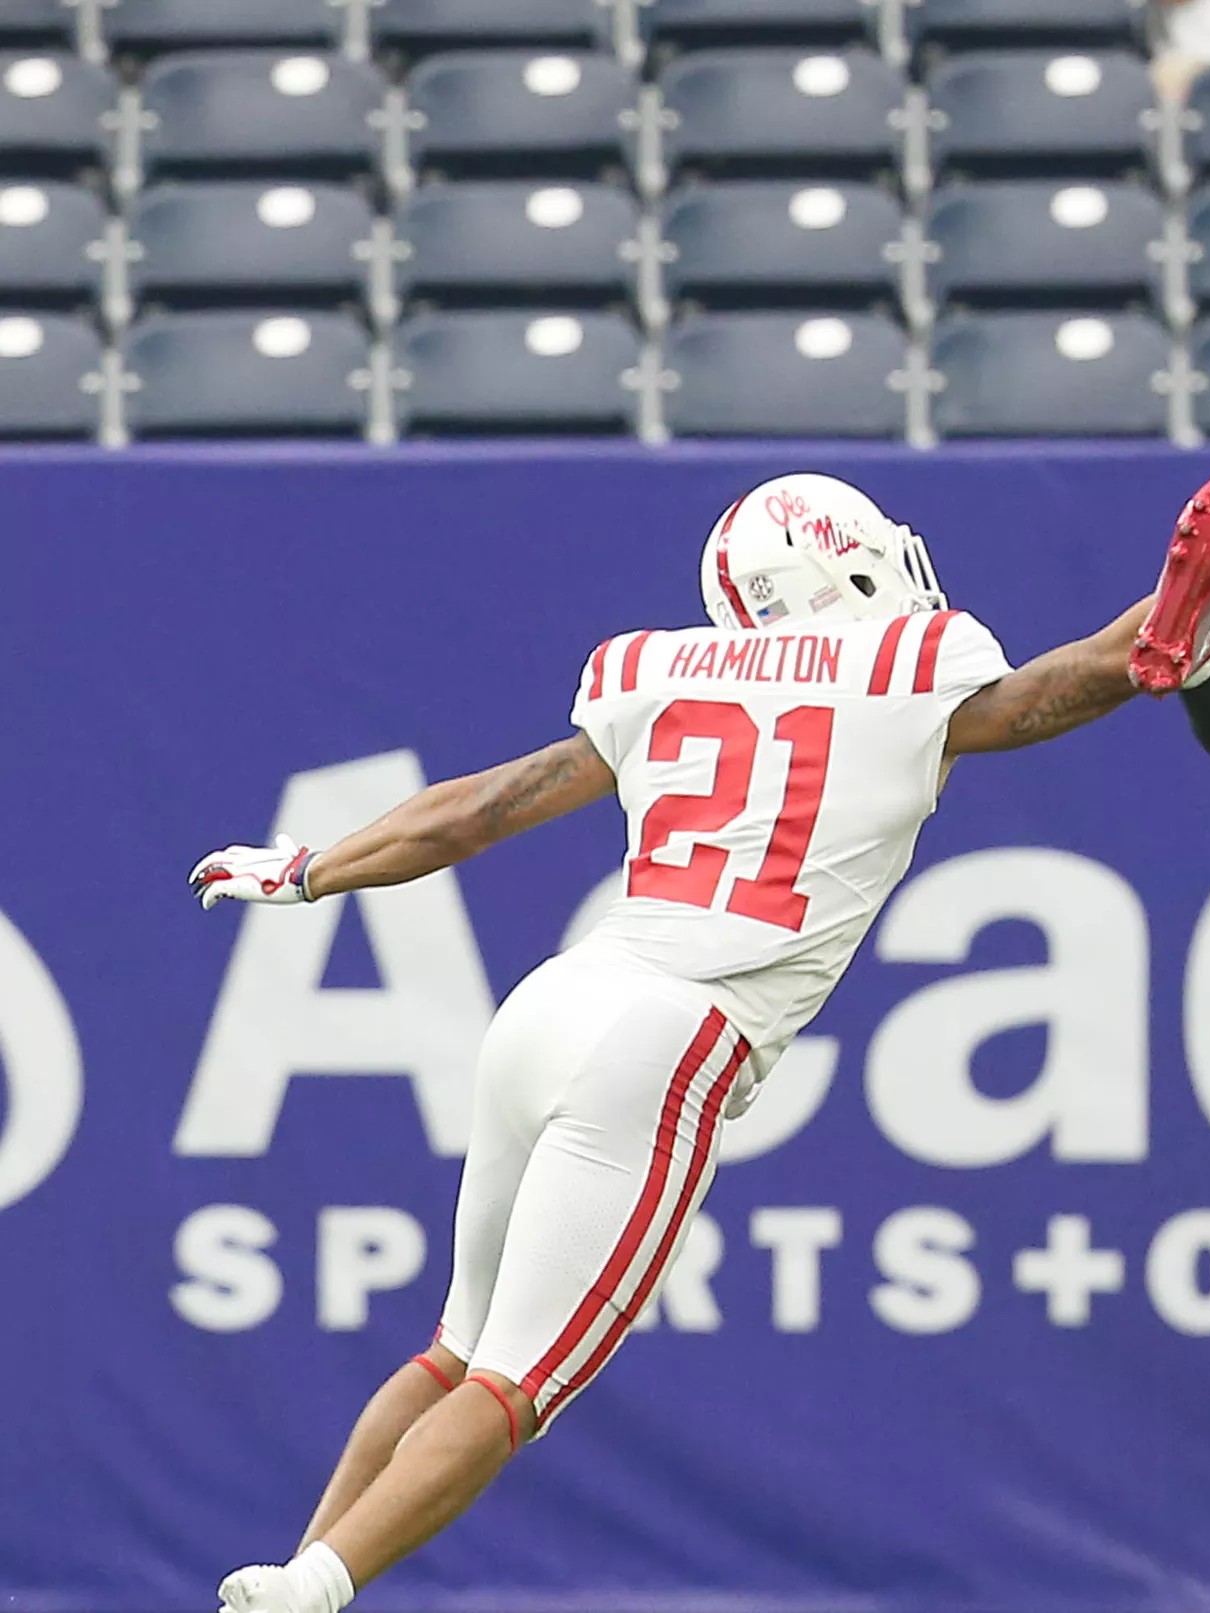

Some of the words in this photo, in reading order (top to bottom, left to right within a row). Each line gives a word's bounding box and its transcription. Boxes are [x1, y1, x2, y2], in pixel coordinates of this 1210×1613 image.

[764, 489, 810, 528] Ole
[667, 634, 843, 684] HAMILTON
[626, 698, 836, 934] 21
